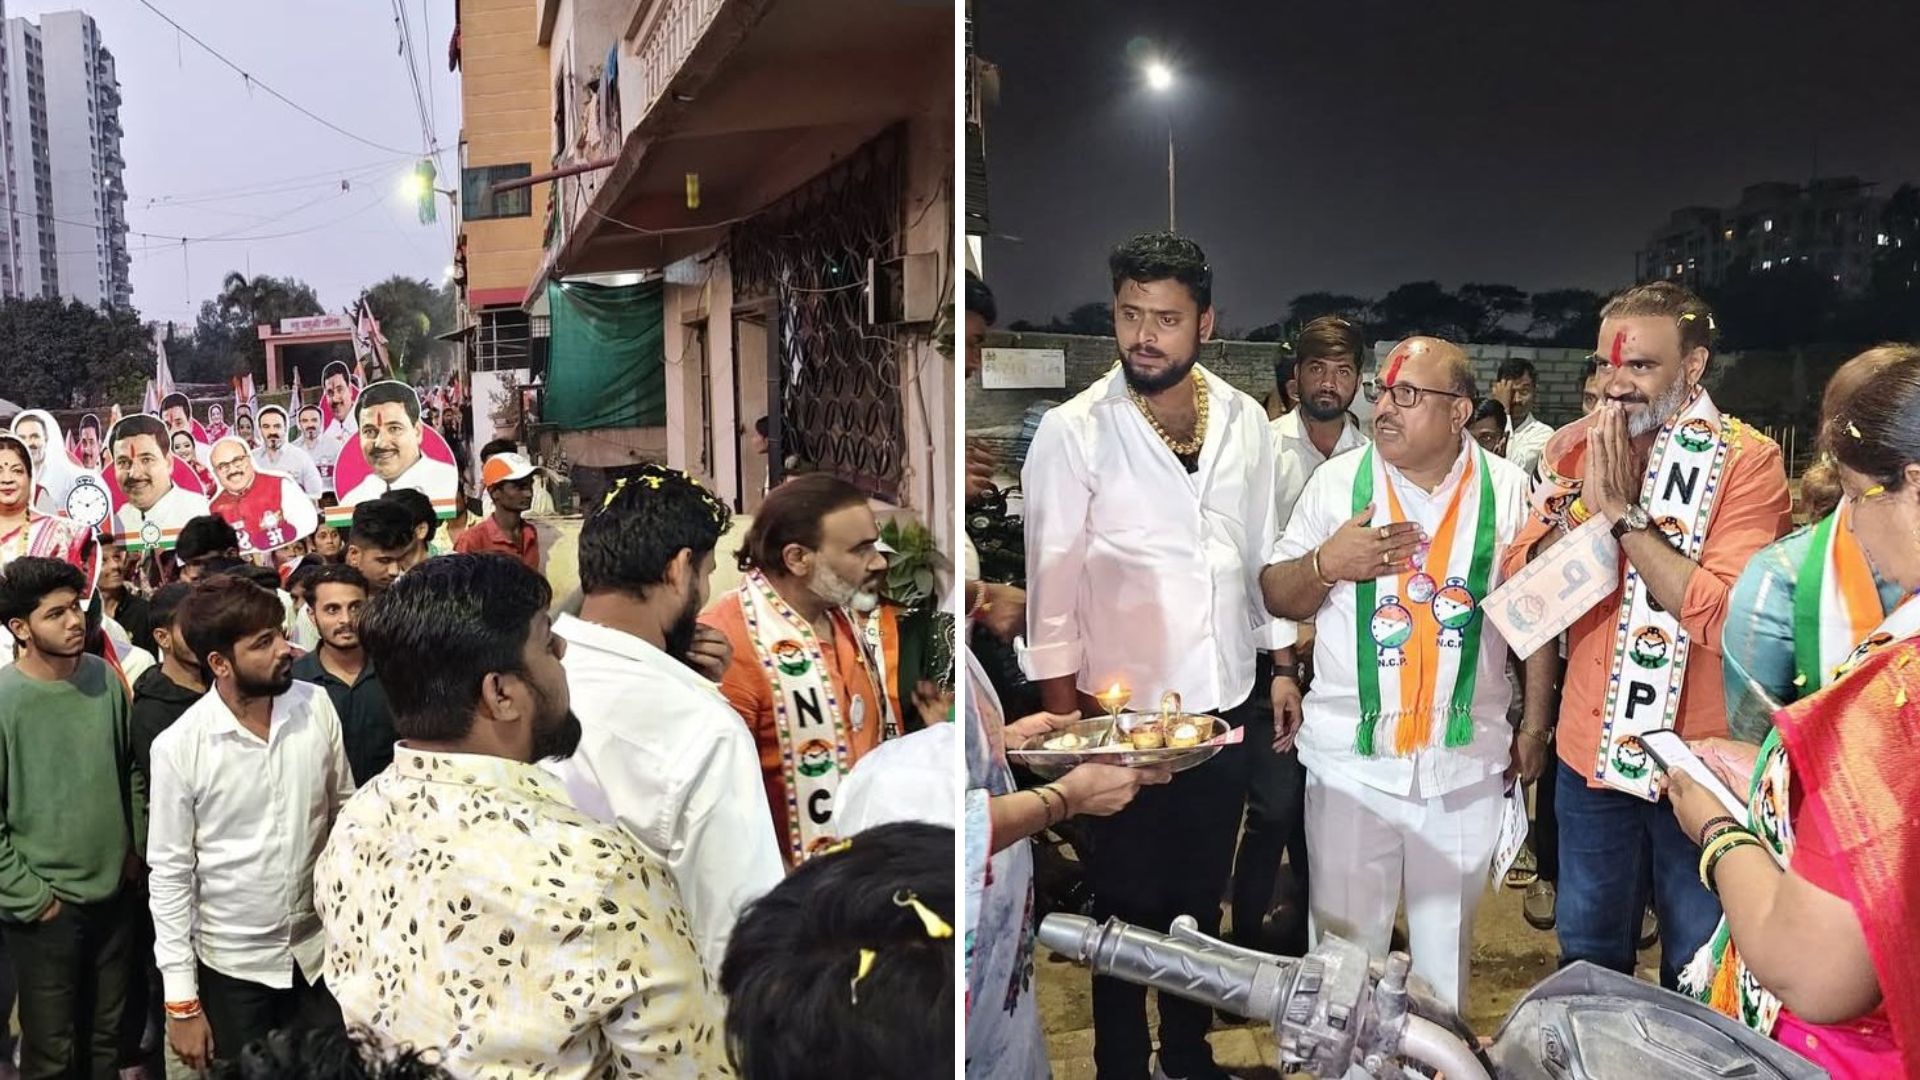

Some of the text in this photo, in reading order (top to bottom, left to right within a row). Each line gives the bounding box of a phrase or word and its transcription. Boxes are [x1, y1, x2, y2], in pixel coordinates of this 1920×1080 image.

[1625, 462, 1700, 720] N P
[793, 687, 832, 824] N C
